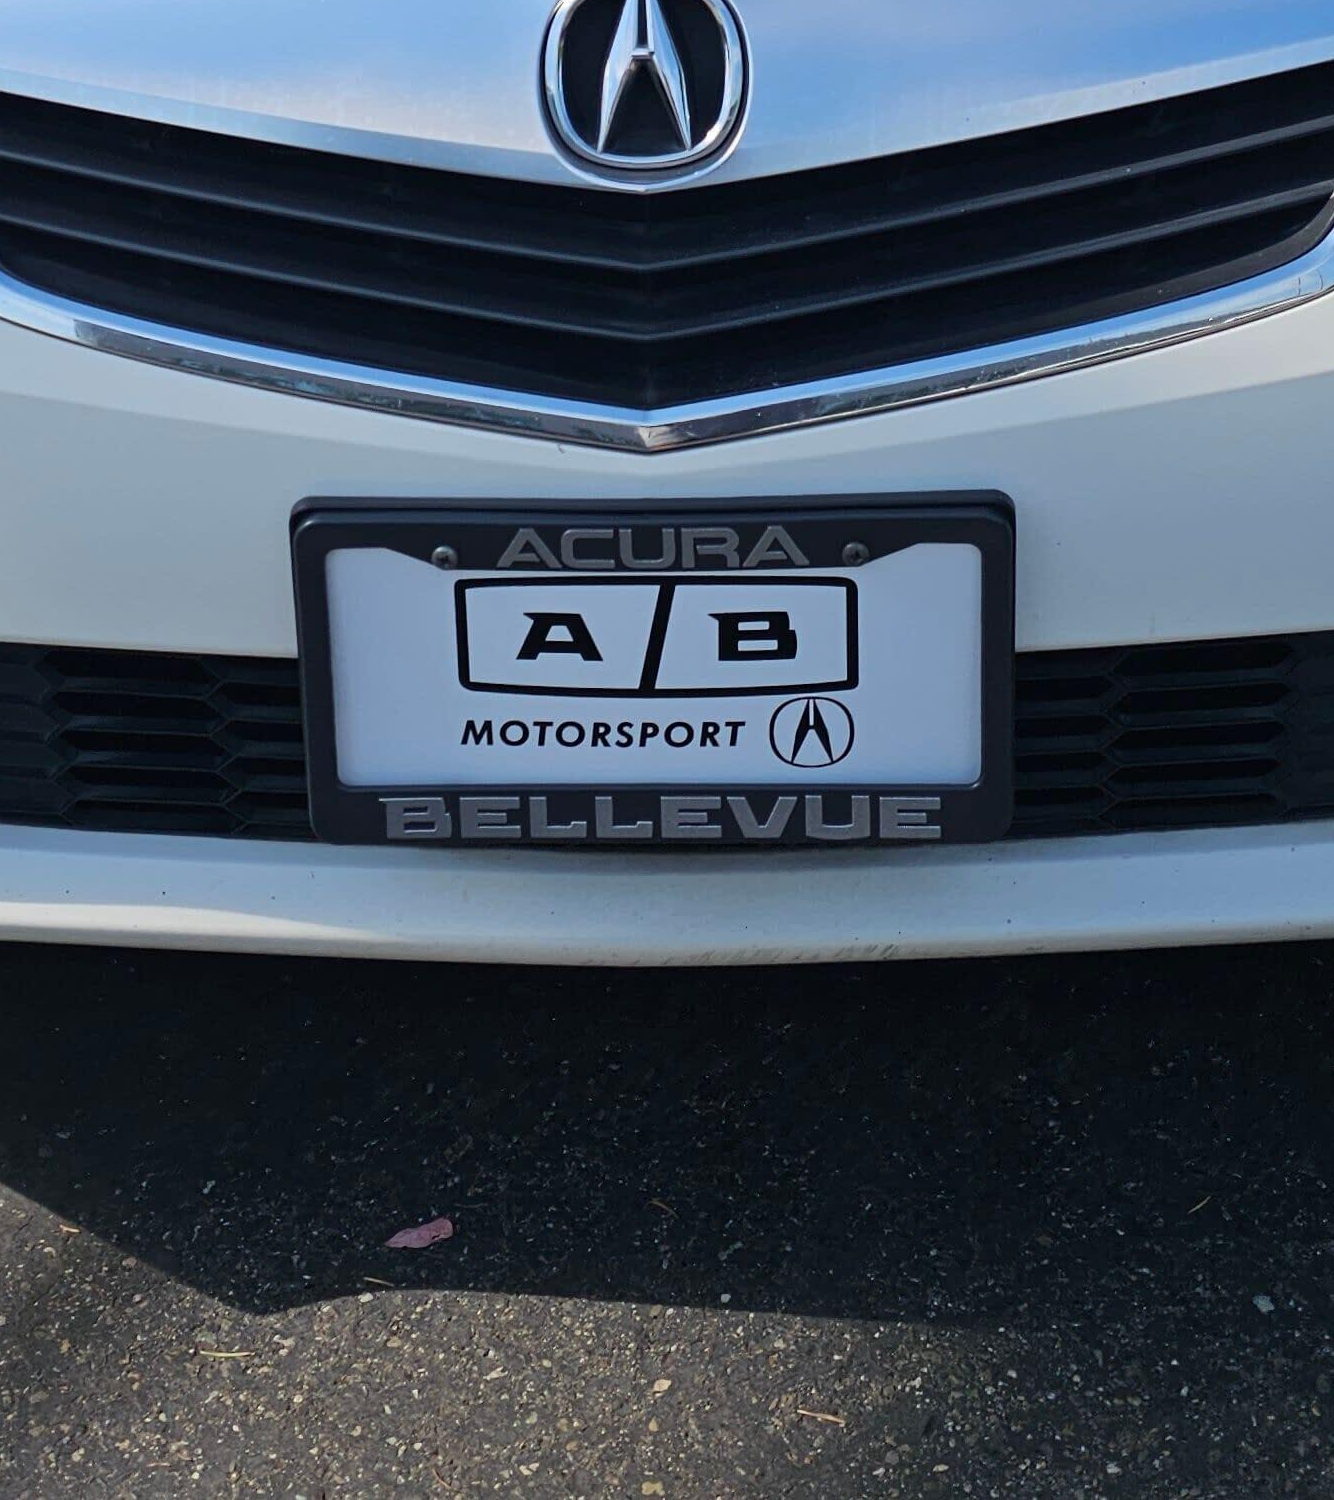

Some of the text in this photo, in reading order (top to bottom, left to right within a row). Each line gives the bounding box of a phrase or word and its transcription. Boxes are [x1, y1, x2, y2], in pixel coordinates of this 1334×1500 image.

[496, 525, 809, 570] ACURA
[515, 610, 798, 662] A B
[460, 719, 747, 749] MOTORSPORT
[378, 796, 943, 841] BELLEVUE
